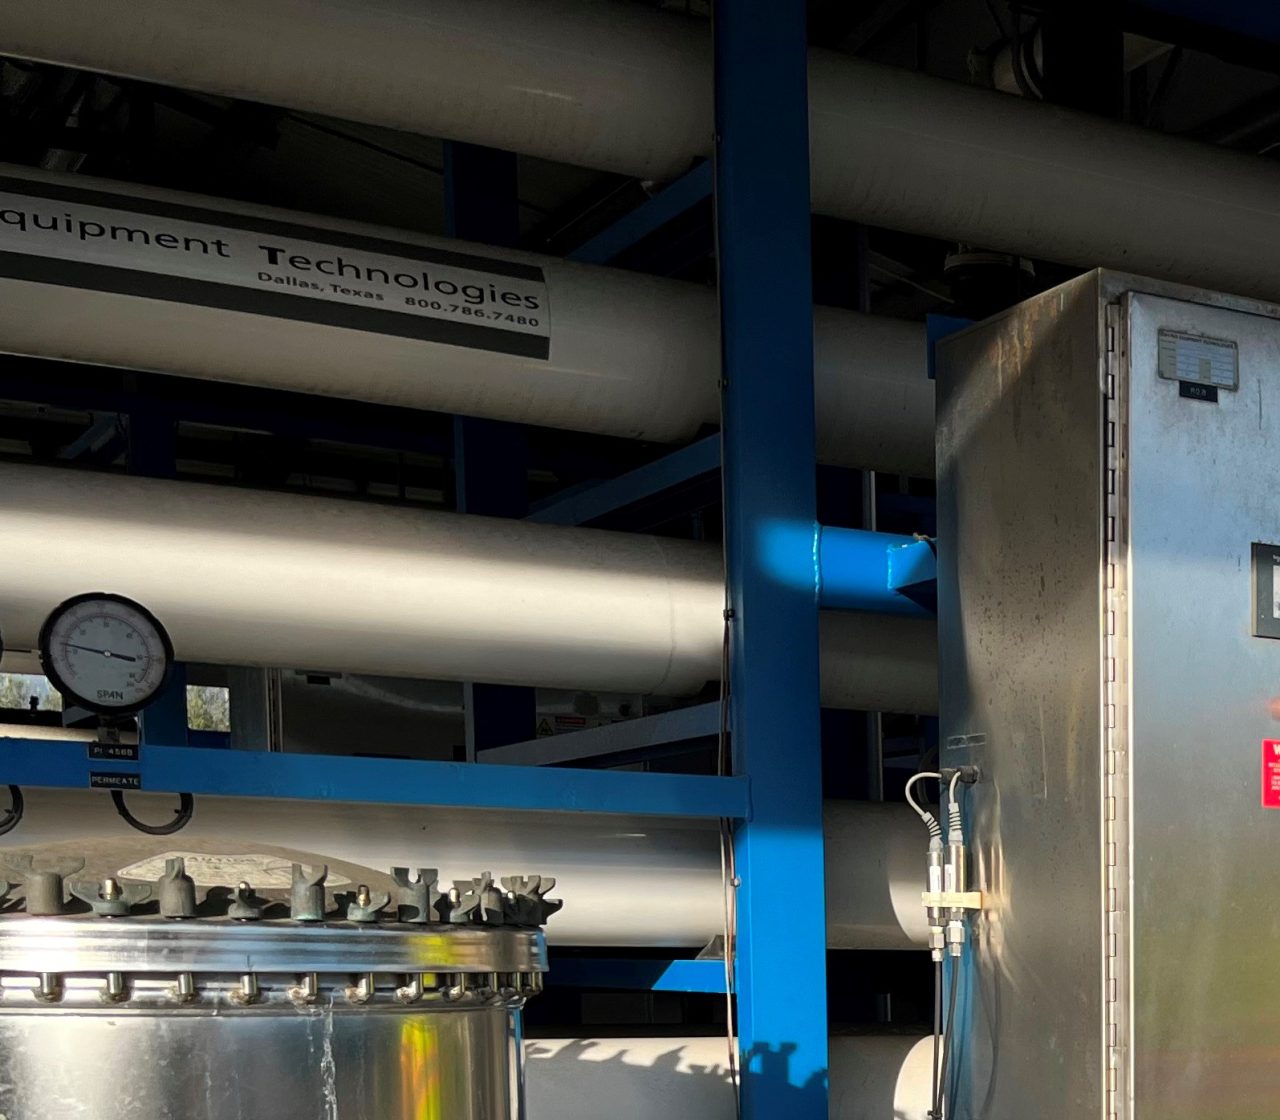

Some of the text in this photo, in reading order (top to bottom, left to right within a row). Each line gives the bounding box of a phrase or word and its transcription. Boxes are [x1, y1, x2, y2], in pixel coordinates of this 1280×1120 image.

[258, 245, 540, 310] Technologies
[257, 271, 540, 328] Dallas, Texas 800.786.7480
[96, 689, 124, 700] SPAN
[91, 775, 140, 786] PERMEATE
